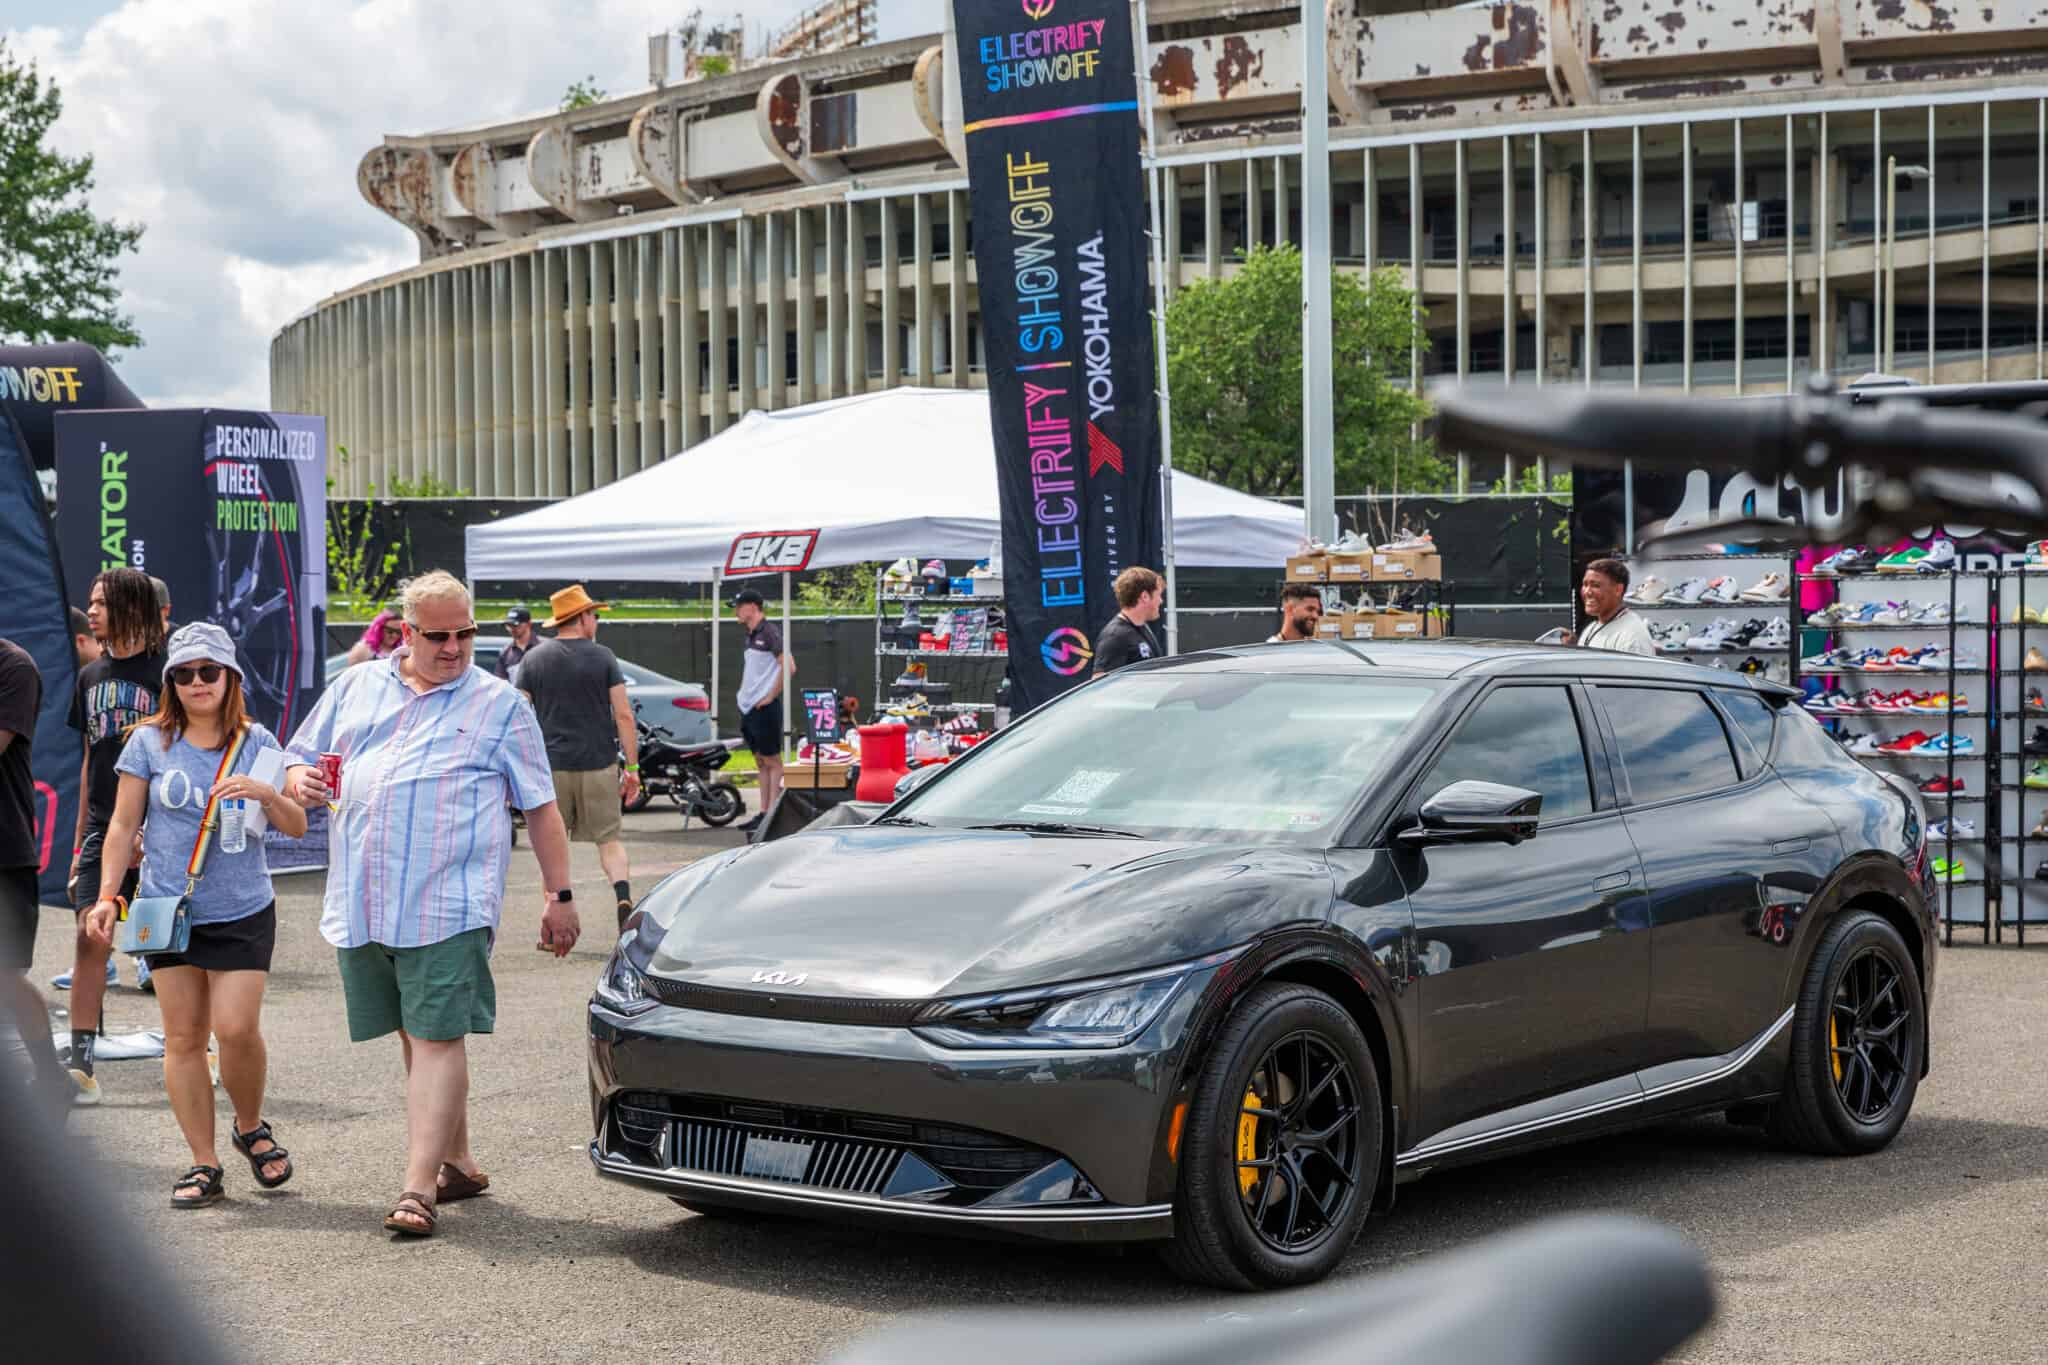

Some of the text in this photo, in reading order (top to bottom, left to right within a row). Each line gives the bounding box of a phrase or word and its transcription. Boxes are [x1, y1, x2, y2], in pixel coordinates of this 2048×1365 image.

[979, 19, 1106, 65] ELECTRIFY
[986, 49, 1100, 93] SHOWOFF
[1077, 236, 1115, 420] YOKOHAMA
[1007, 151, 1085, 608] ELECTRIFY SHOWOFF
[216, 424, 316, 461] PERSONALIZED
[216, 461, 263, 495] WHEEL
[216, 499, 297, 532] PROTECTION
